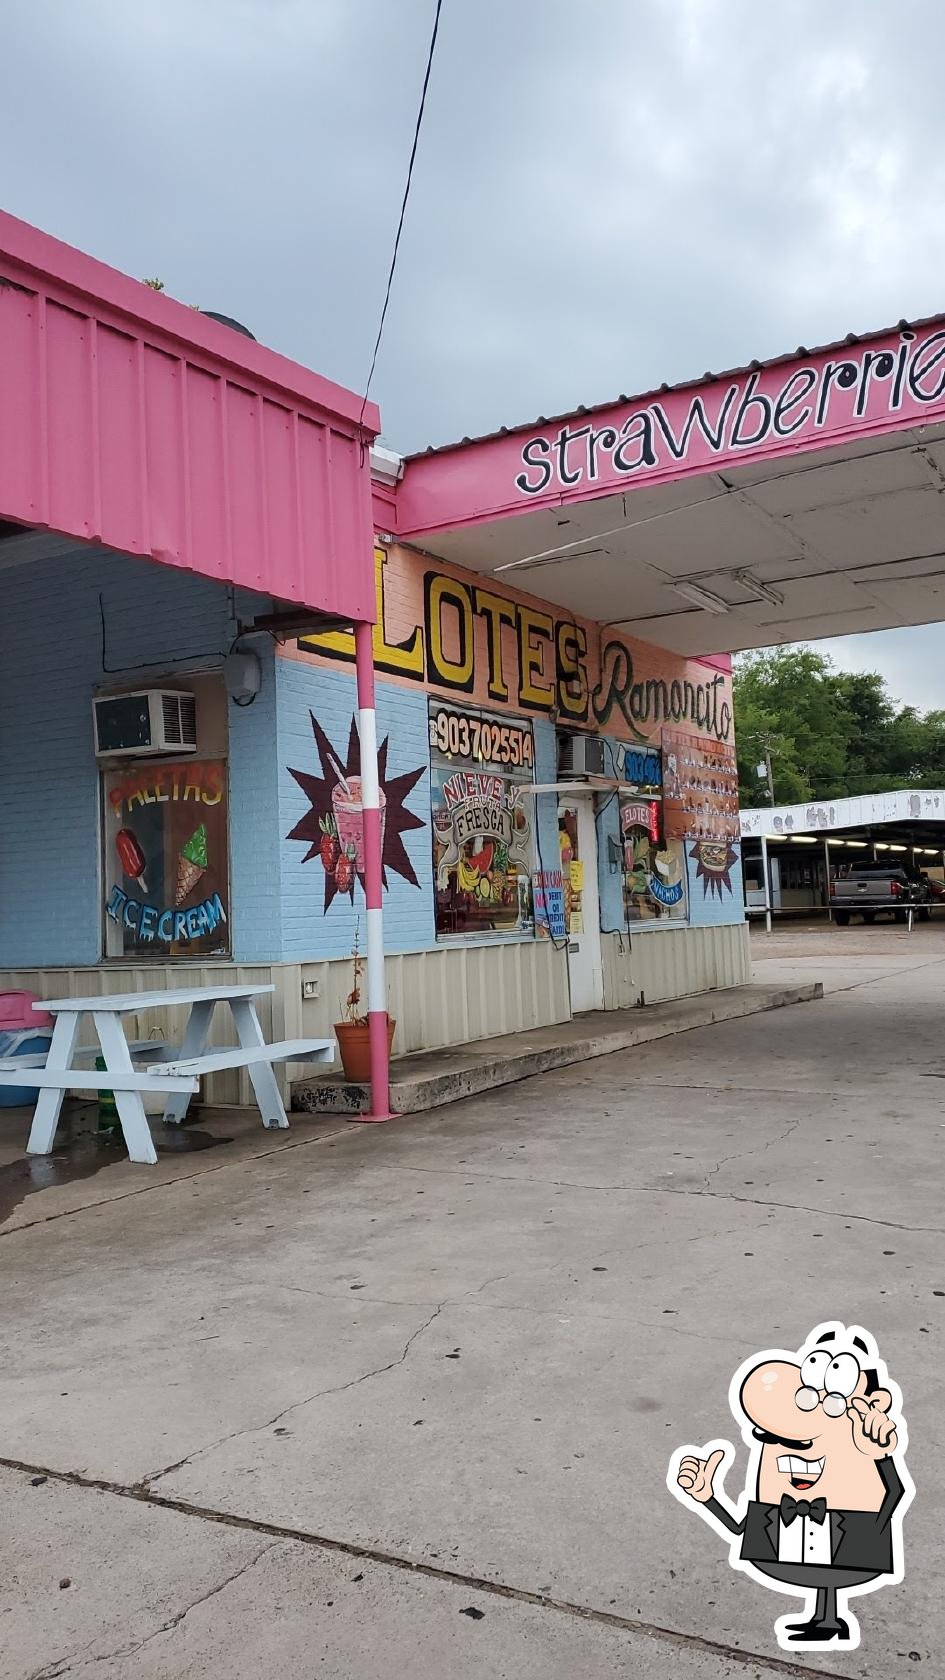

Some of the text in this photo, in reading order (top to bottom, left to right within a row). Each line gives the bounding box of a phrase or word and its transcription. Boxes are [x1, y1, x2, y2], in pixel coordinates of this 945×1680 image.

[515, 331, 945, 494] strawberrie
[297, 546, 731, 740] LOTES Ramoncito
[437, 709, 533, 767] 9037025514
[443, 772, 503, 811] NIEVE
[464, 796, 501, 812] FRUTA
[456, 806, 505, 837] FRESCA
[624, 807, 650, 824] ELOTES
[653, 878, 679, 902] NACHOS
